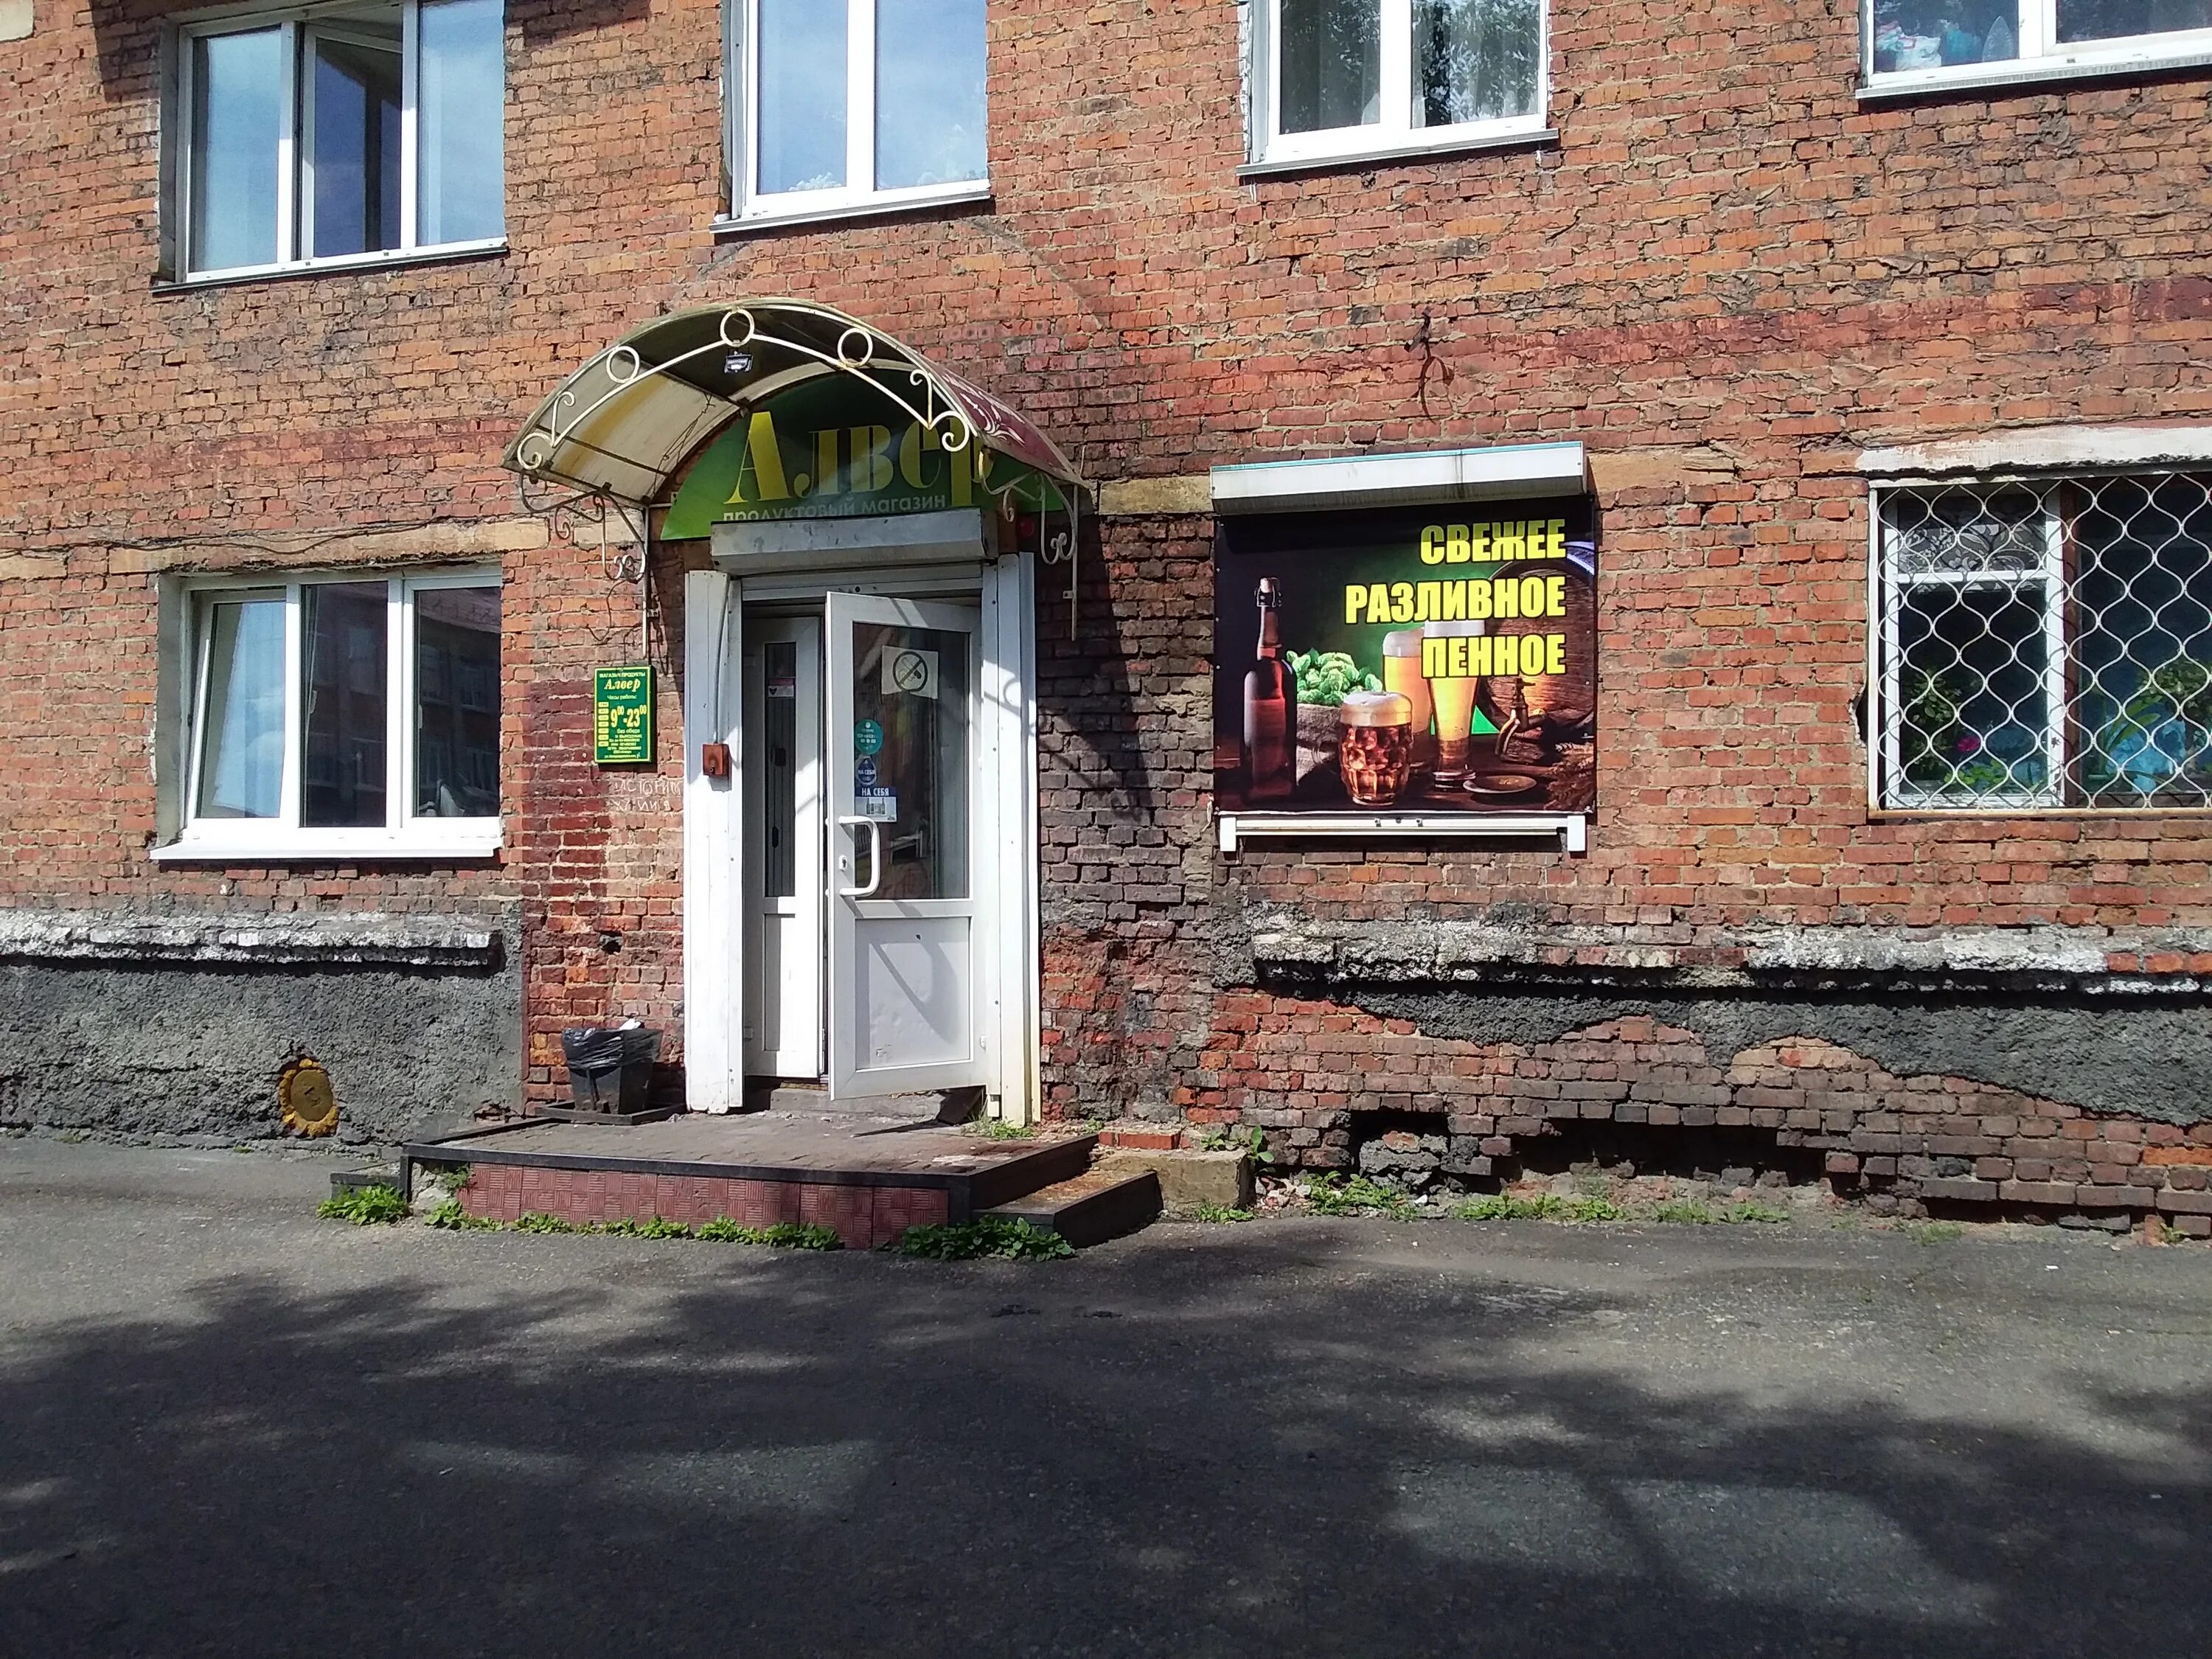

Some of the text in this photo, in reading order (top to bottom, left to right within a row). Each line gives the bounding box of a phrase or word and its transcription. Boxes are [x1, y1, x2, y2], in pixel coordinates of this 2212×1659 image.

[861, 495, 946, 515] магазин
[1420, 518, 1566, 564] СВЕЖЕЕ
[1346, 576, 1566, 624] РАЗЛИВНОЕ
[1422, 633, 1566, 678] ПЕННОЕ
[861, 787, 889, 796] НА СЕБЯ
